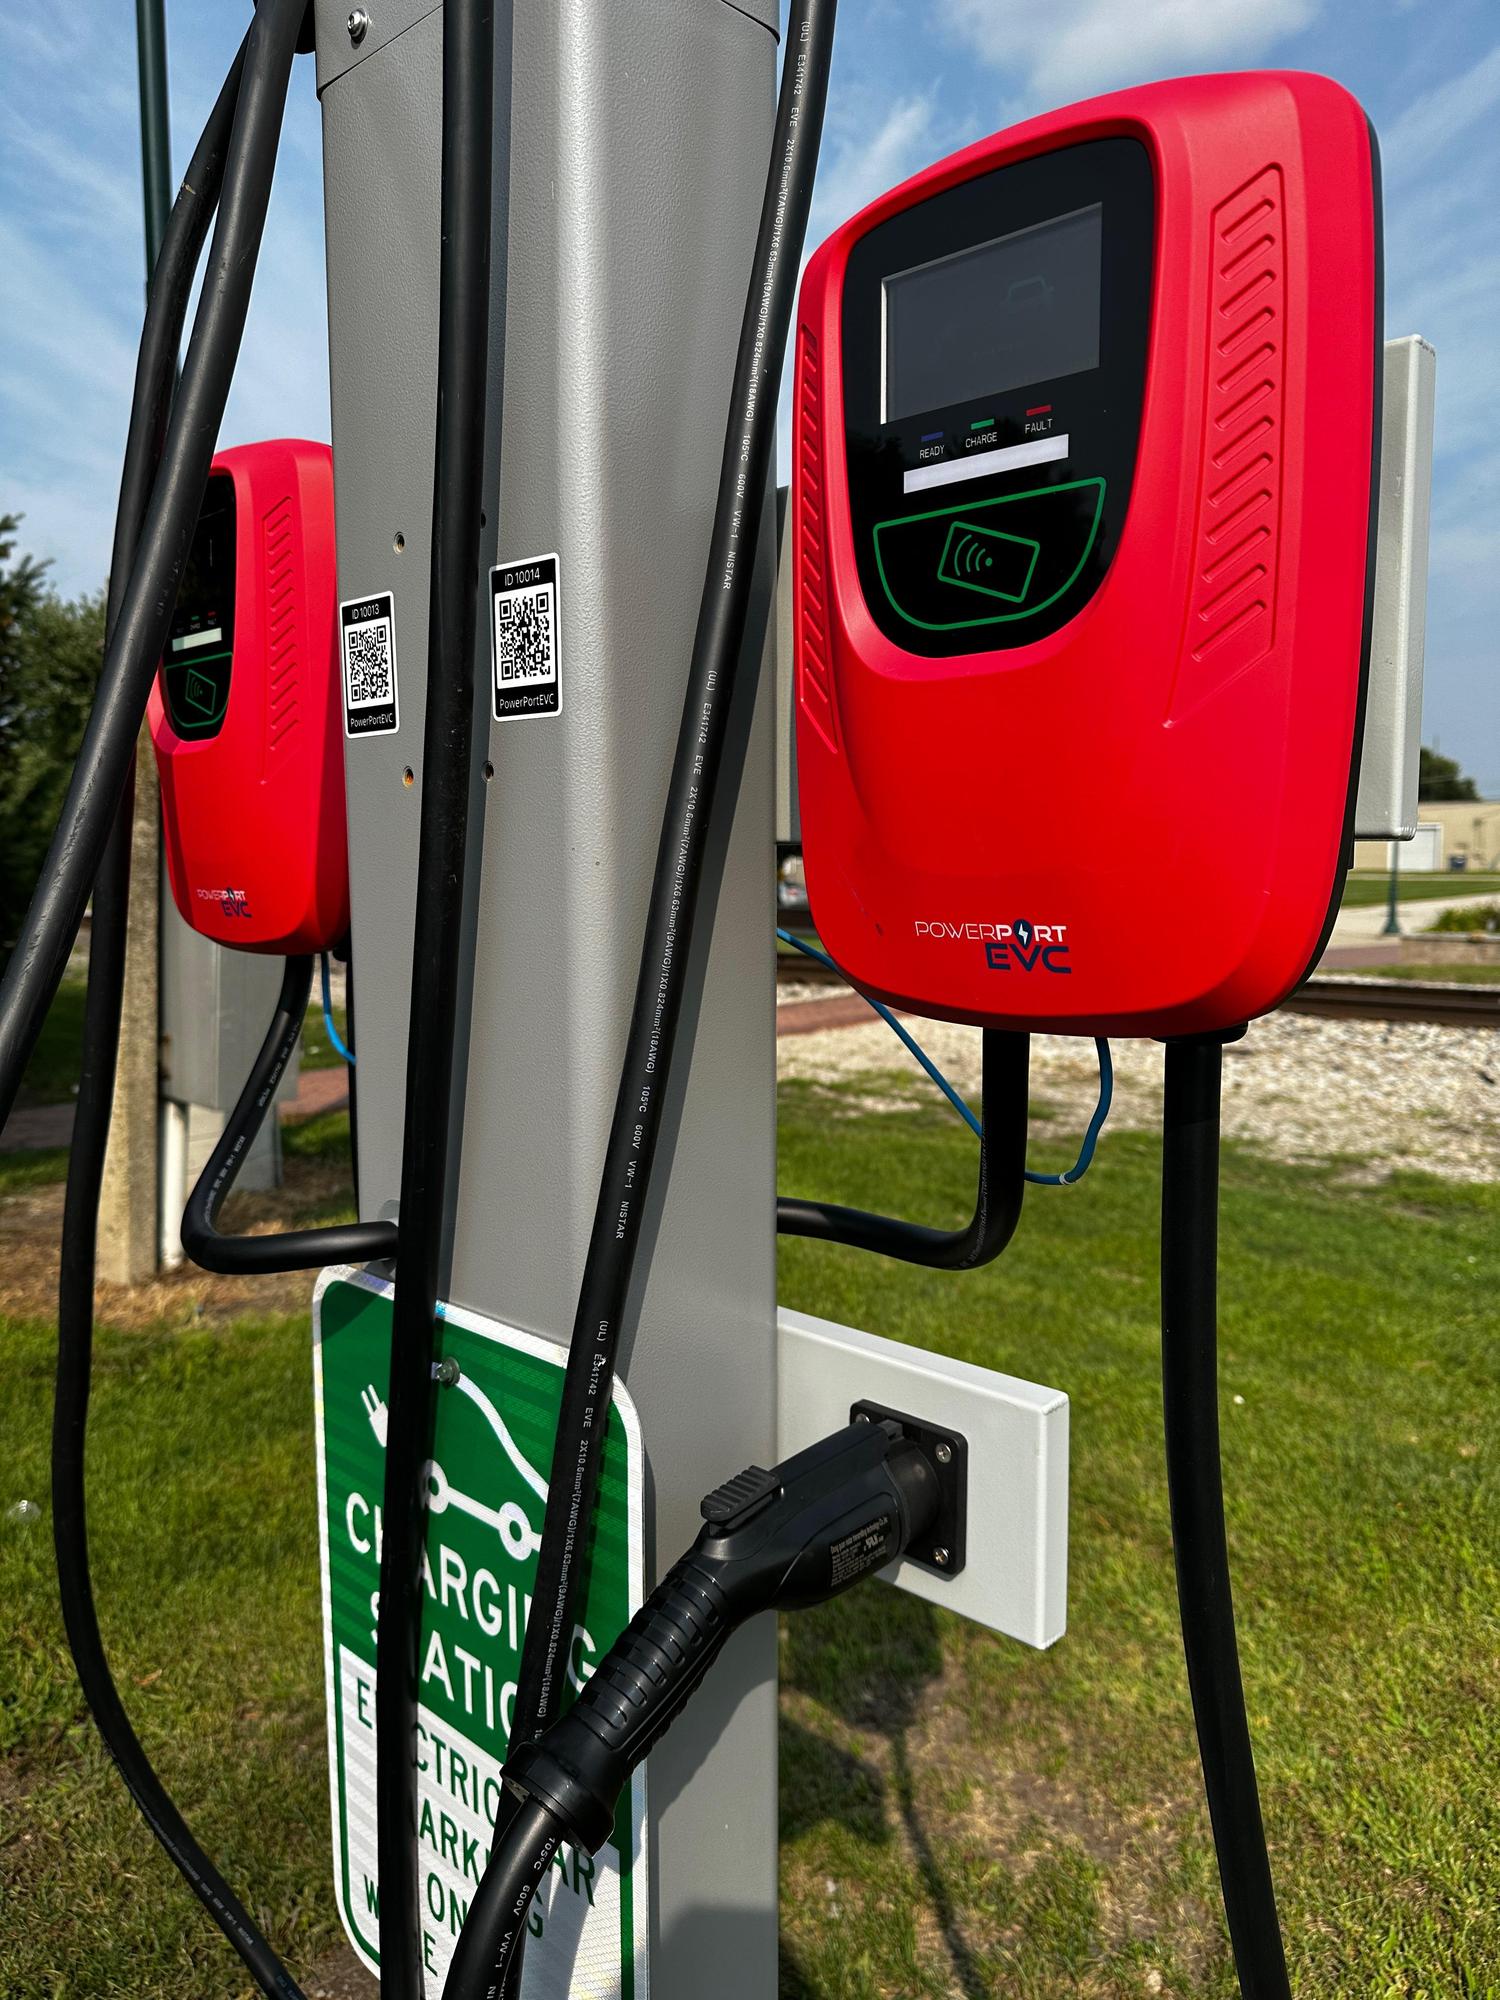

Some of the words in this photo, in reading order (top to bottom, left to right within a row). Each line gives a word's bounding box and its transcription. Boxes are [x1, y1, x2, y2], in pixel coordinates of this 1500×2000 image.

[800, 21, 811, 43] (UL)
[793, 54, 806, 95] E341742
[789, 107, 799, 127] EVE
[1024, 418, 1053, 434] FAULT
[965, 431, 998, 448] CHARGE
[919, 444, 945, 460] READY
[736, 473, 746, 498] 600V
[730, 509, 742, 539] VW-1
[504, 573, 514, 587] ID
[515, 567, 541, 585] 10014
[723, 550, 737, 590] NISTAR
[351, 608, 359, 620] ID
[360, 603, 380, 619] 10013
[706, 670, 718, 691] (UL)
[499, 693, 555, 709] PowerPortEVC
[350, 712, 393, 728] PowerPortEVC
[698, 702, 712, 744] E341742
[693, 754, 704, 776] EVE
[984, 942, 1072, 974] EVC
[632, 1124, 643, 1150] 600V
[625, 1160, 637, 1189] VW-1
[615, 1200, 630, 1239] NISTAR
[596, 1320, 609, 1342] (UL)
[583, 1407, 594, 1429] EVE
[547, 1844, 596, 1908] AR
[513, 1884, 531, 1917] 600V
[495, 1931, 513, 1968] VW-1
